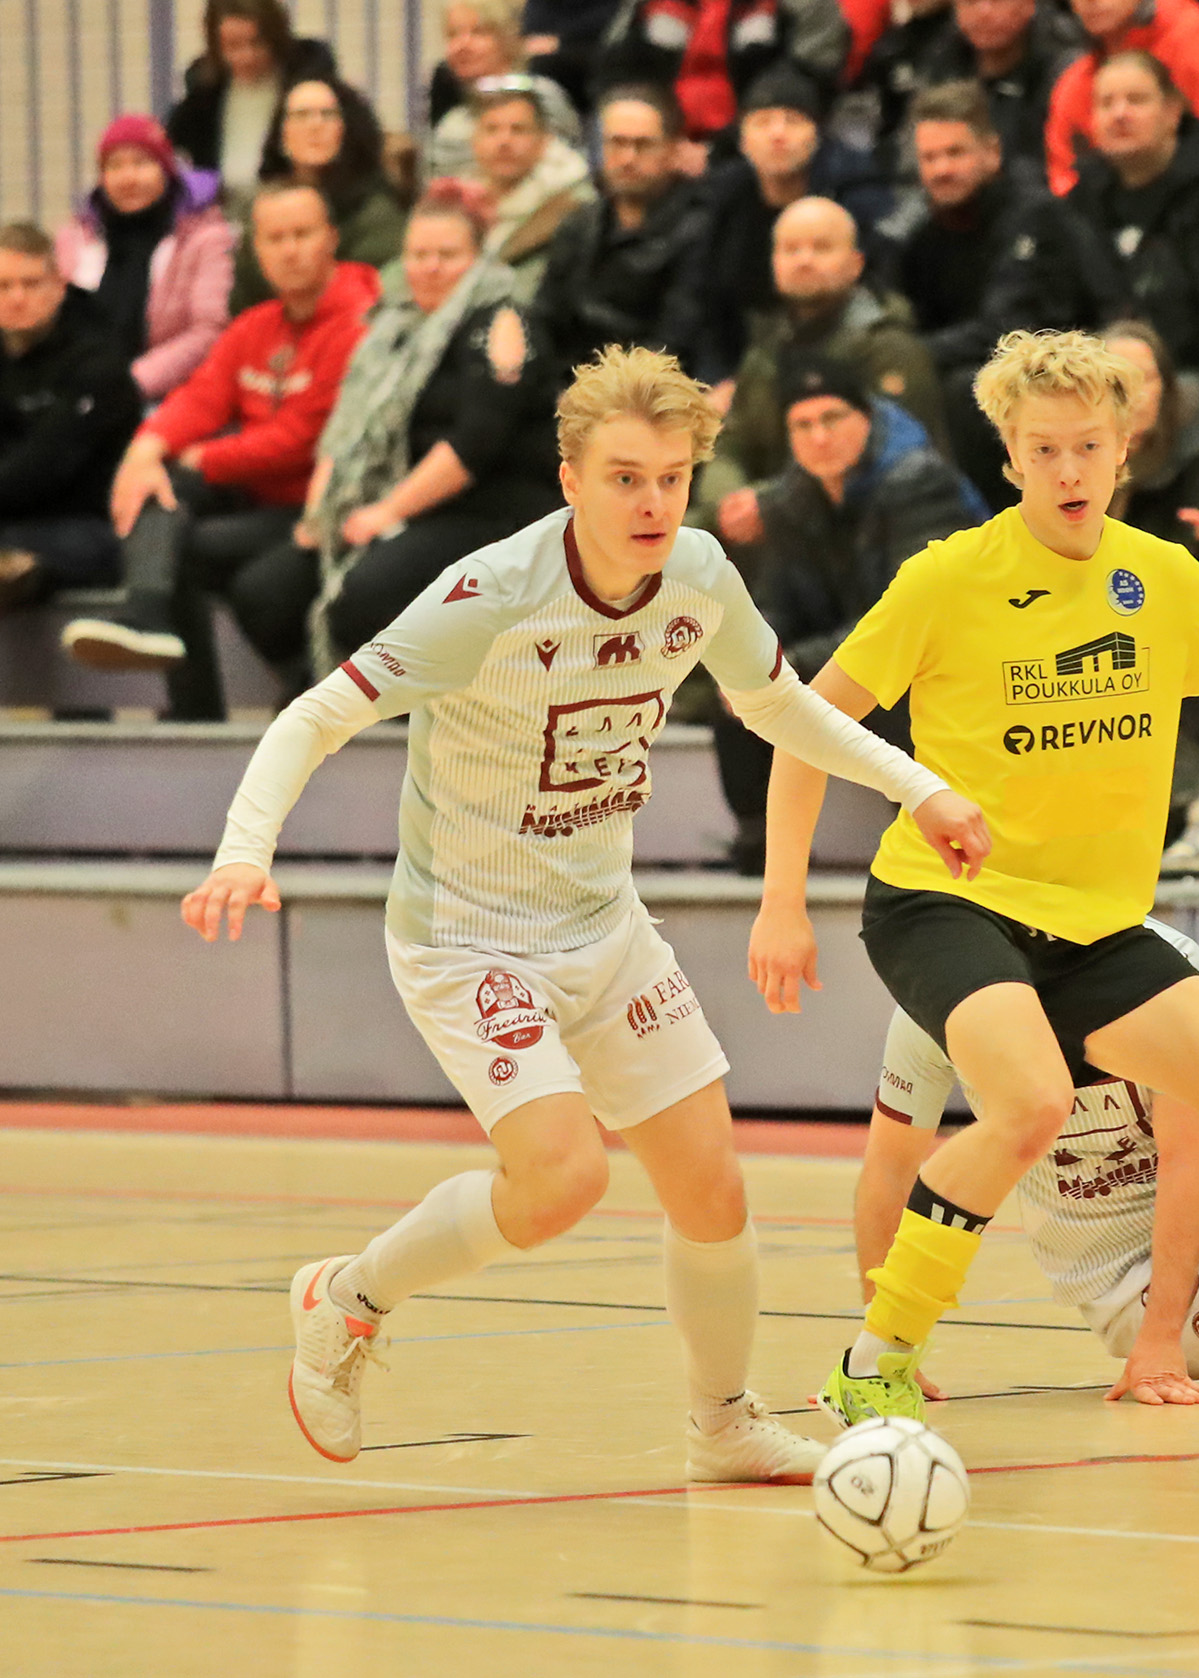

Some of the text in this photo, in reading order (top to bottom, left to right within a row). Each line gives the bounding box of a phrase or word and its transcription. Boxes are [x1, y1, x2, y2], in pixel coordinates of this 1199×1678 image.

[1010, 664, 1048, 682] RKL
[1012, 671, 1143, 701] POUKKULA OY
[1041, 712, 1153, 751] REVNOR
